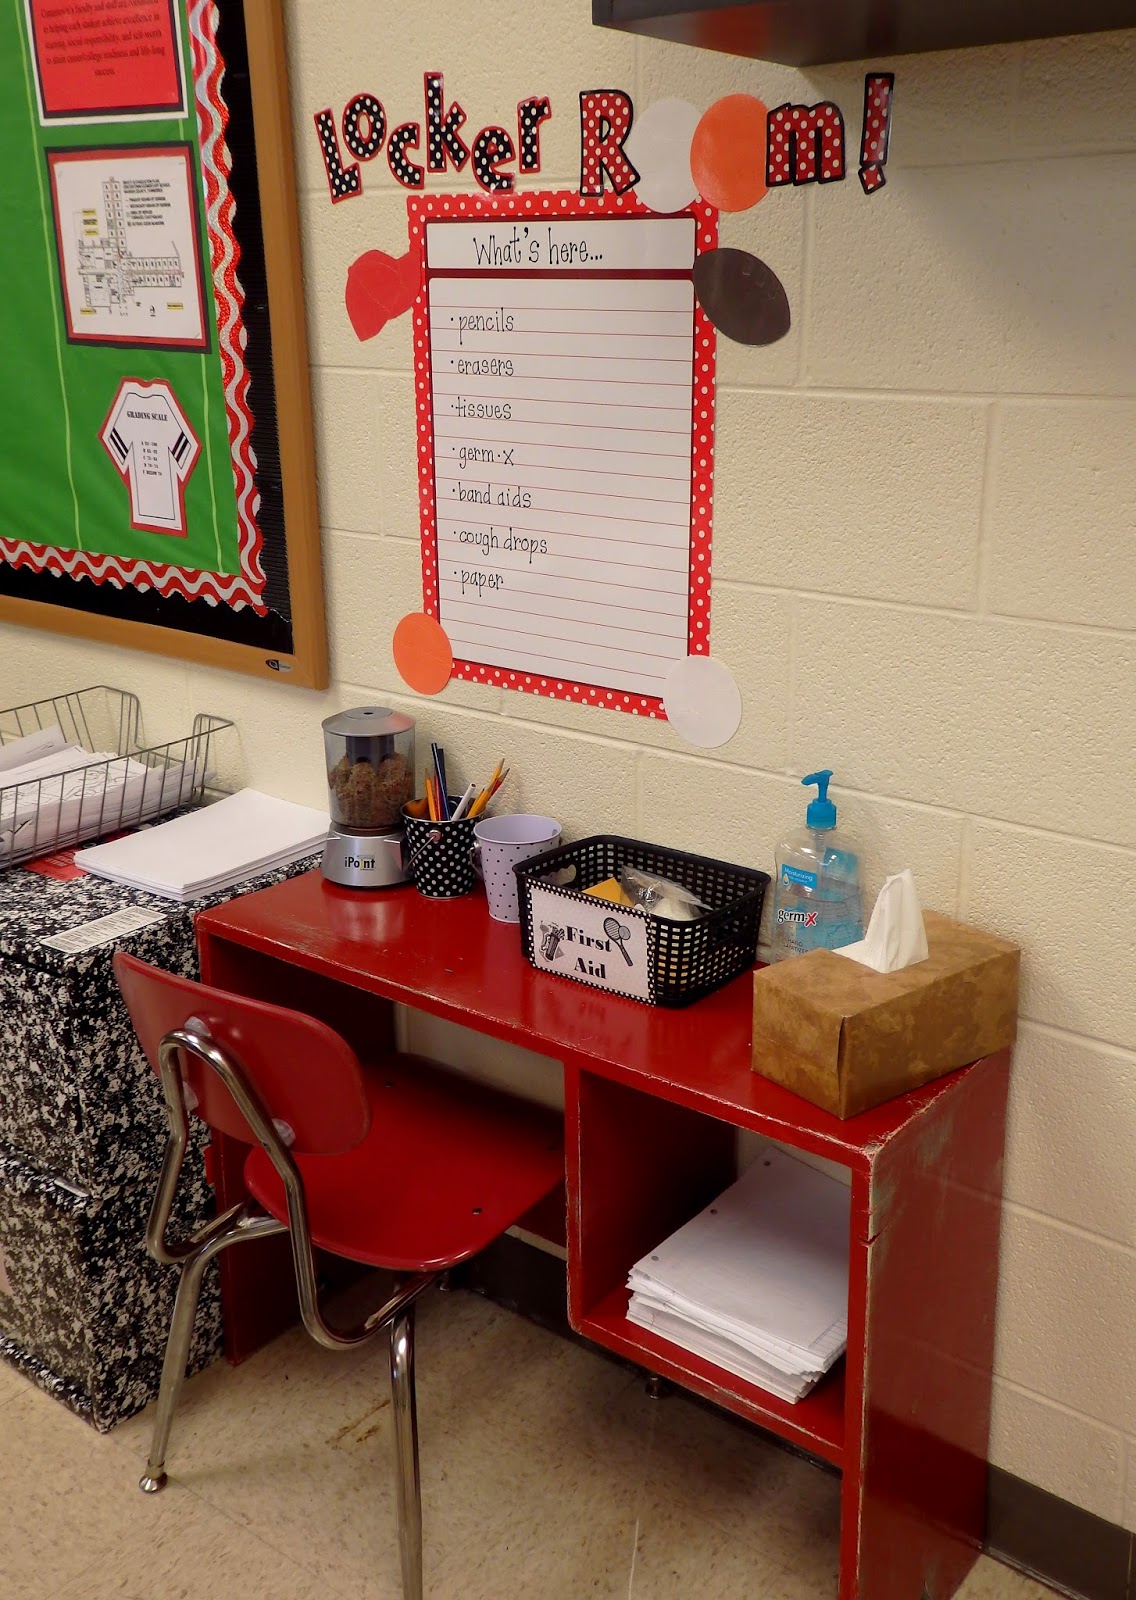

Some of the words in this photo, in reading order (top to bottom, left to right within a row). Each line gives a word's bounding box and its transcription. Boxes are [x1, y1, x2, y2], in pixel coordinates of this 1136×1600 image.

[314, 71, 552, 203] Locker
[473, 226, 540, 265] What's
[459, 307, 514, 345] pencils
[458, 358, 514, 376] erasers
[126, 410, 150, 420] GRADING
[151, 412, 168, 422] SCALE
[455, 396, 512, 419] tissues
[458, 481, 491, 504] band
[497, 486, 531, 508] aids
[459, 527, 499, 555] cough
[503, 527, 548, 564] drops
[461, 570, 504, 597] paper
[565, 926, 613, 952] First
[574, 957, 607, 979] Aid
